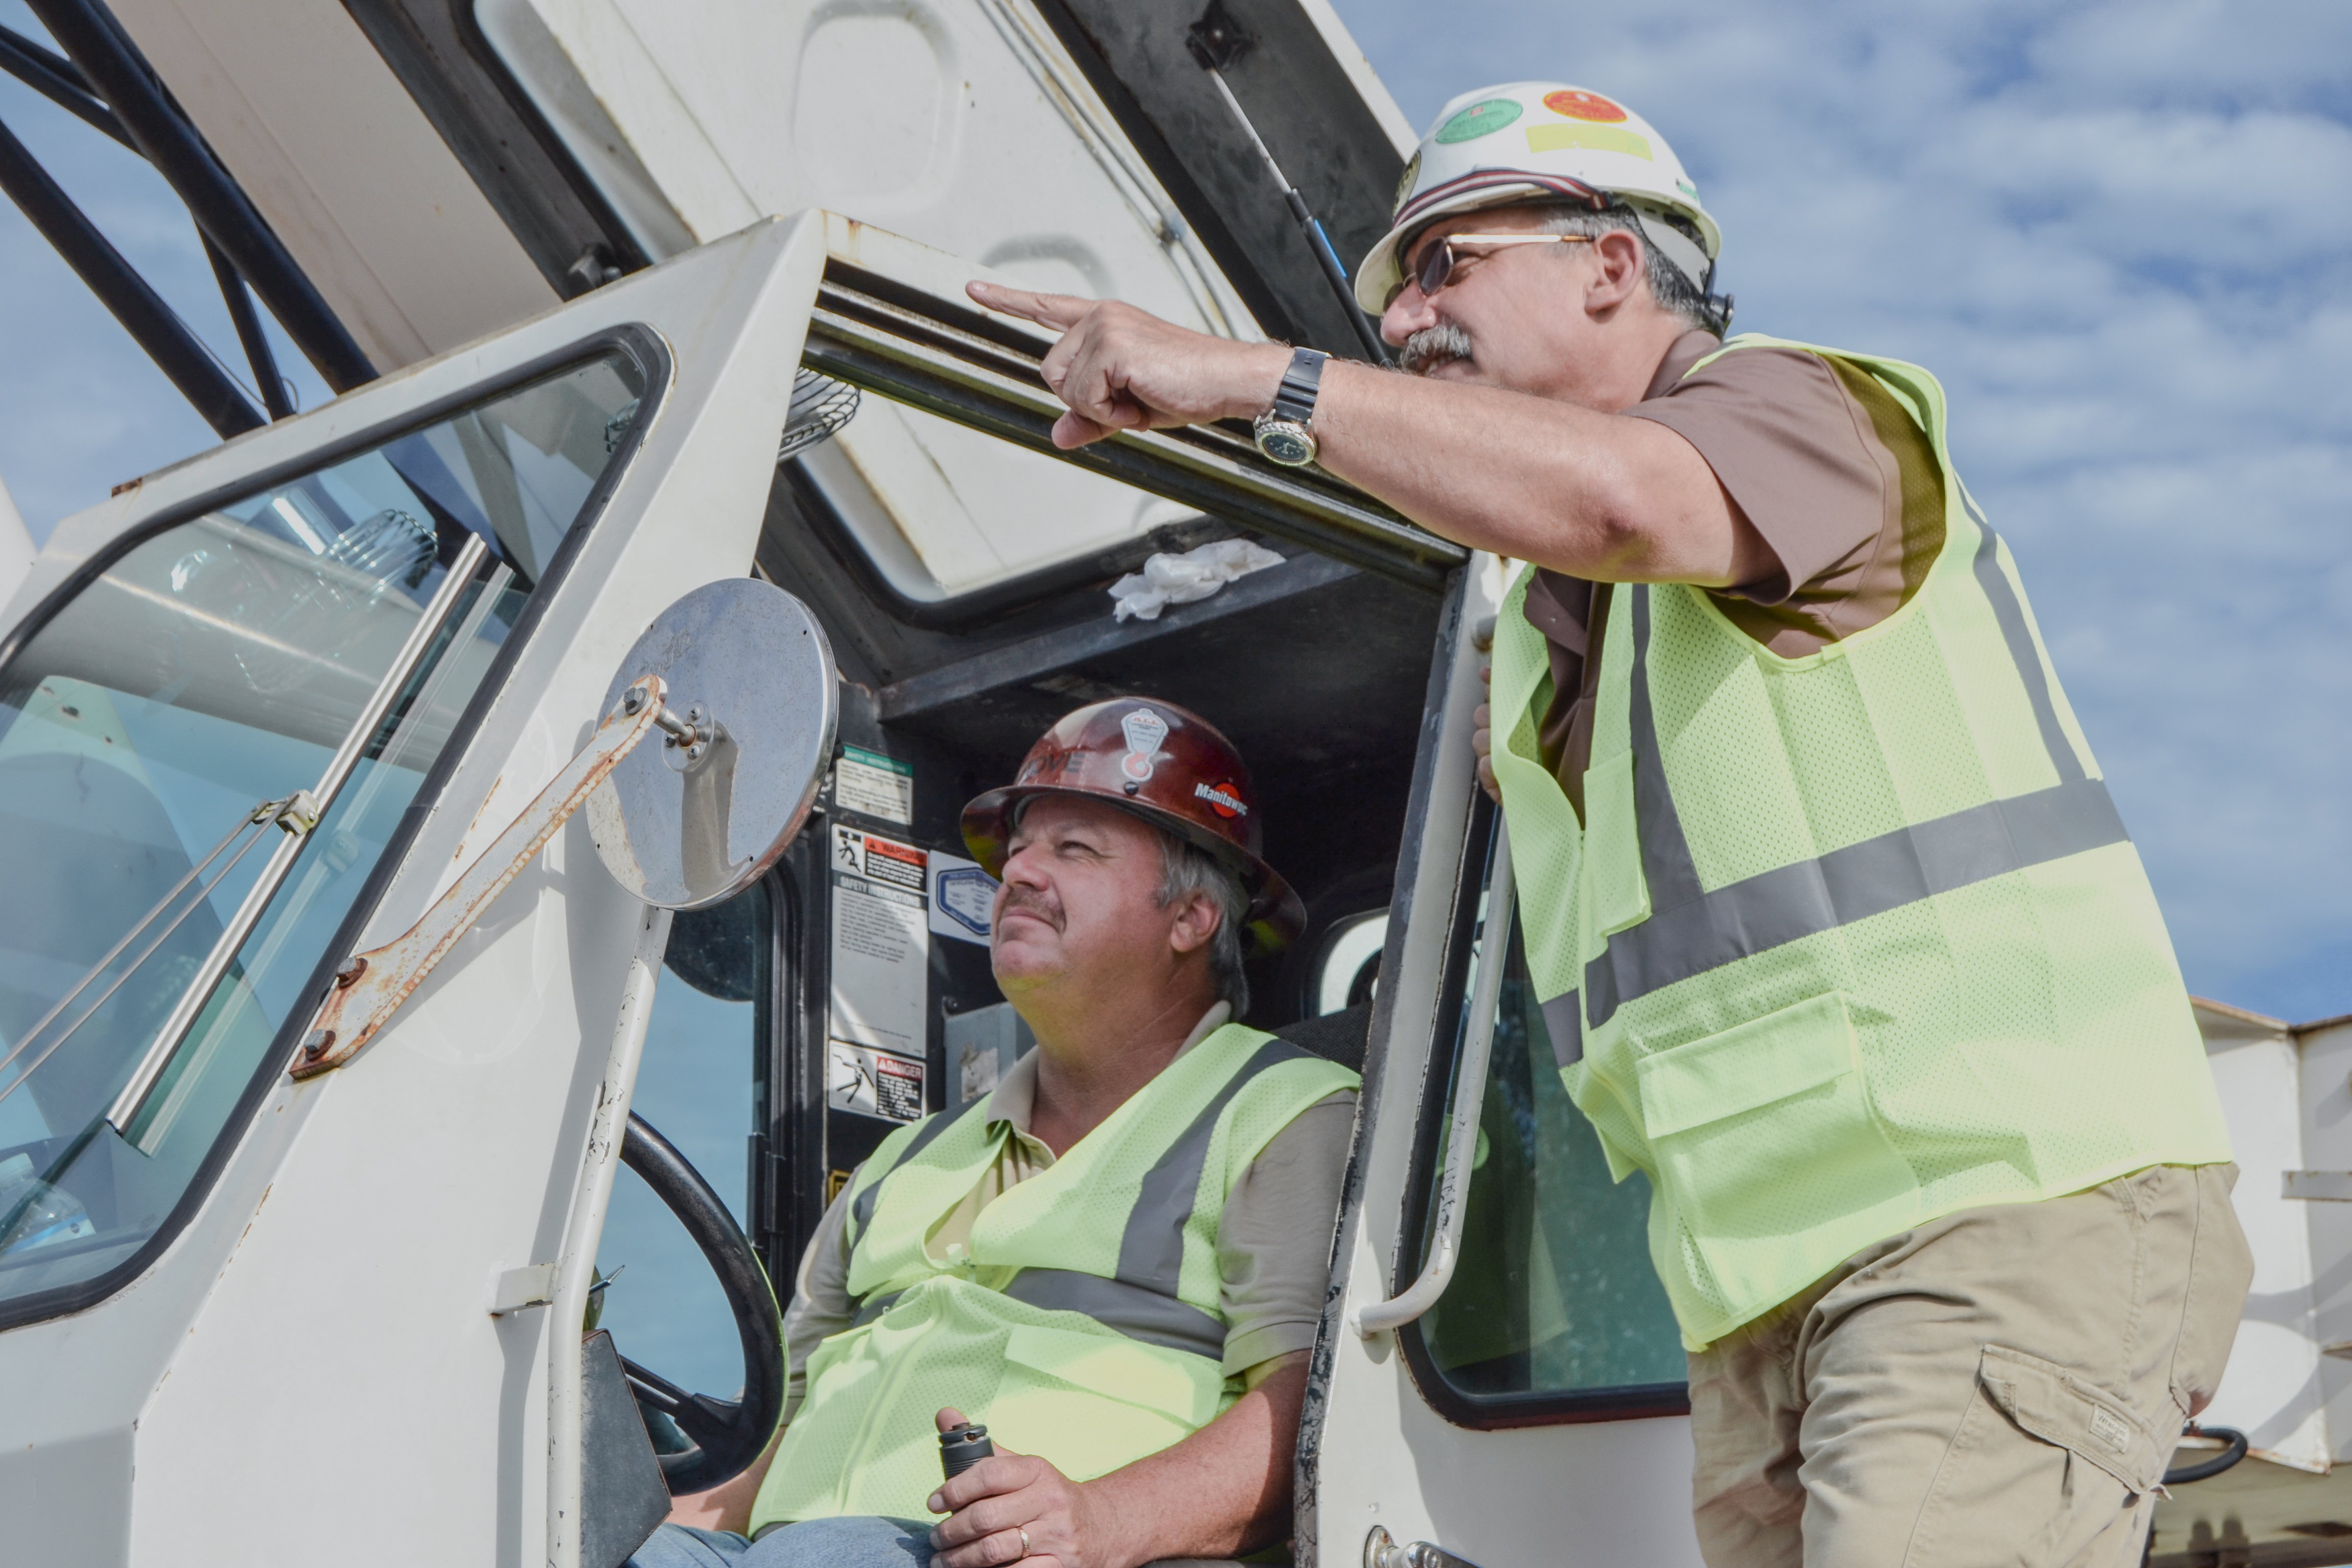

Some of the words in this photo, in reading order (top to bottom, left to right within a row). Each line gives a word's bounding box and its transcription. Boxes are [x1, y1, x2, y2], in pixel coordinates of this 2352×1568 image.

[1195, 782, 1248, 816] Manitowoc
[883, 843, 924, 862] WARNING
[841, 876, 867, 893] SAFETY
[868, 884, 921, 908] INSTRUCTIONS
[887, 1060, 922, 1079] DANGER
